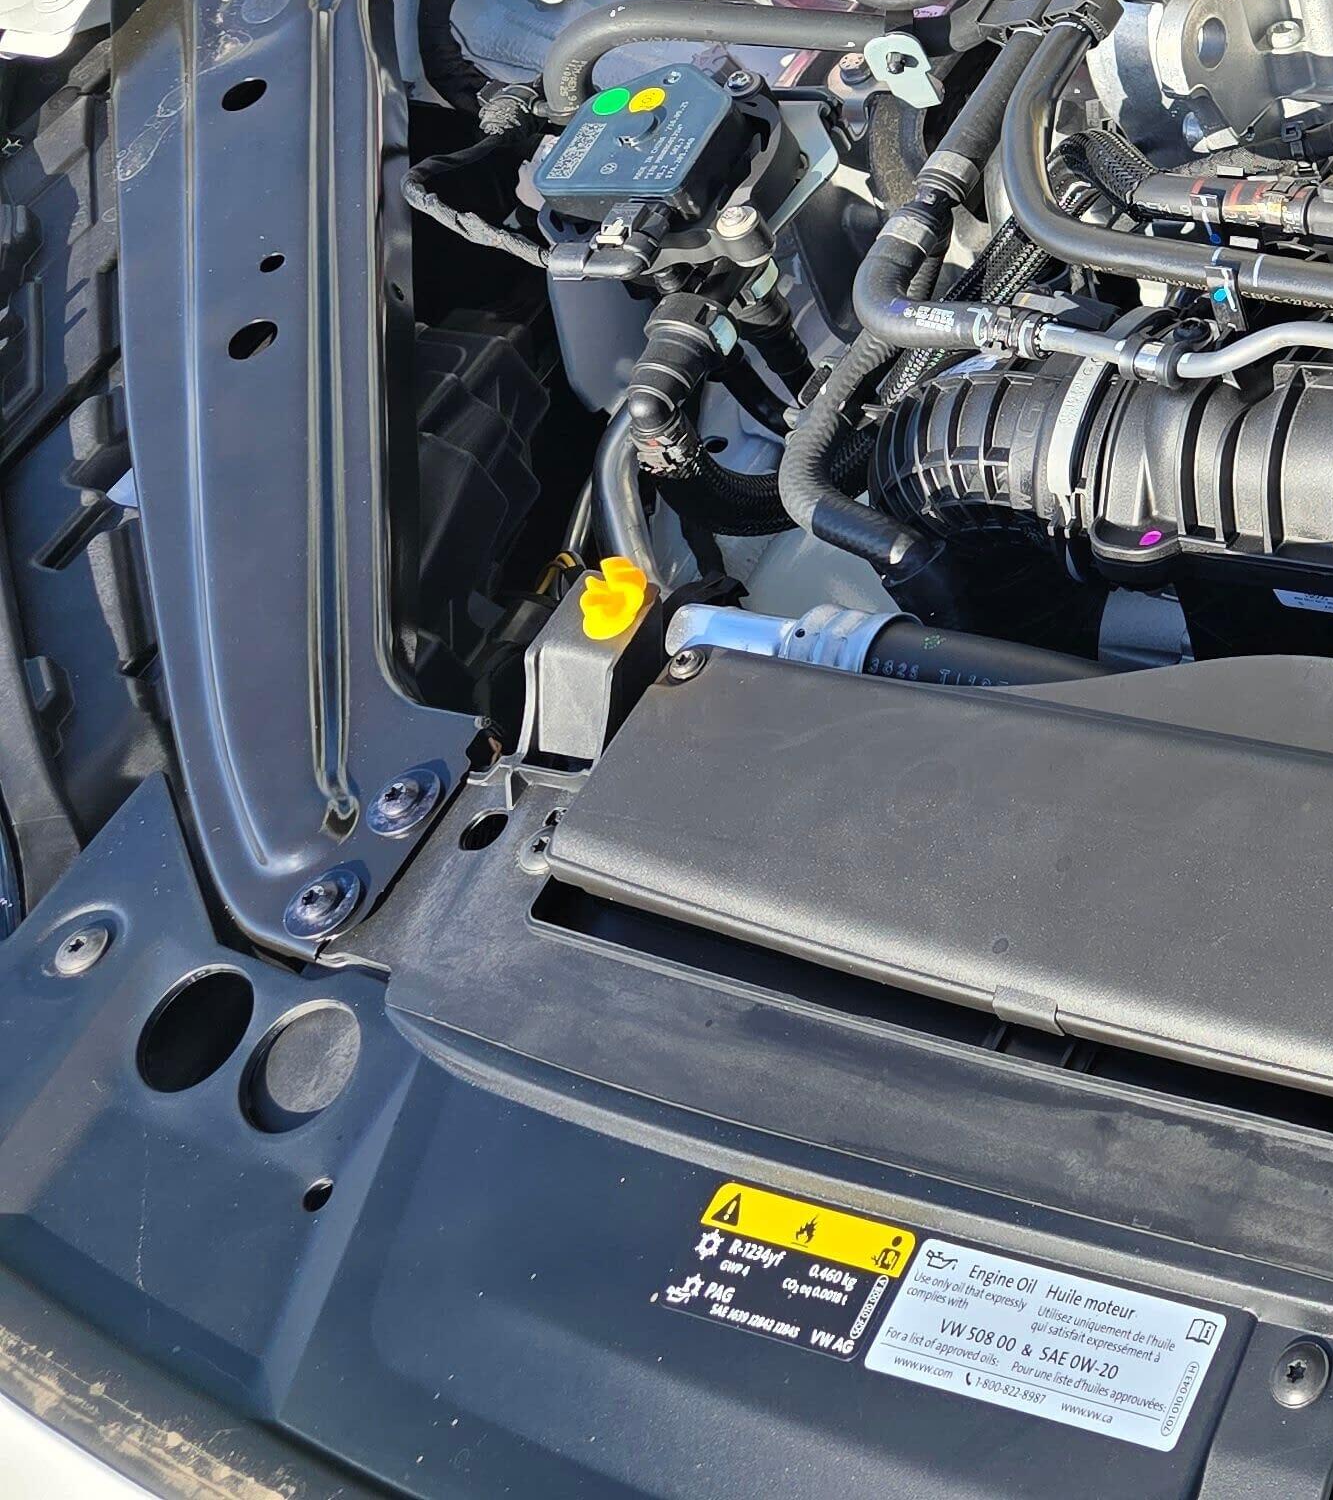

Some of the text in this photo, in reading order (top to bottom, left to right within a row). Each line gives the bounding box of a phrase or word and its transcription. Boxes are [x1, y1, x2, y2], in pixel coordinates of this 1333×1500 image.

[724, 1236, 787, 1272] R-1234yf
[701, 1280, 737, 1305] PAG
[806, 1262, 860, 1293] 0.460 kg
[911, 1269, 1029, 1313] Use only oil that expressly
[965, 1263, 1039, 1294] Engine Oil
[903, 1284, 970, 1310] complies with
[1043, 1283, 1137, 1320] Huile moteur
[806, 1328, 857, 1355] VW AG
[884, 1325, 1002, 1367] For a list of approved oils:
[1027, 1319, 1163, 1363] qui satisfait expressément à
[1035, 1304, 1177, 1352] Utilisez uniquement de l'huile
[936, 1317, 1120, 1380] VW 508 00 & SAE 0W-20
[891, 1354, 954, 1380] www.vw.com
[973, 1375, 1047, 1405] 1-800-822-8987
[1009, 1360, 1169, 1415] Pour une liste d'huiles approuvées:
[1162, 1364, 1198, 1432] 701 010 043 H
[1059, 1400, 1114, 1424] www.vw.ca
